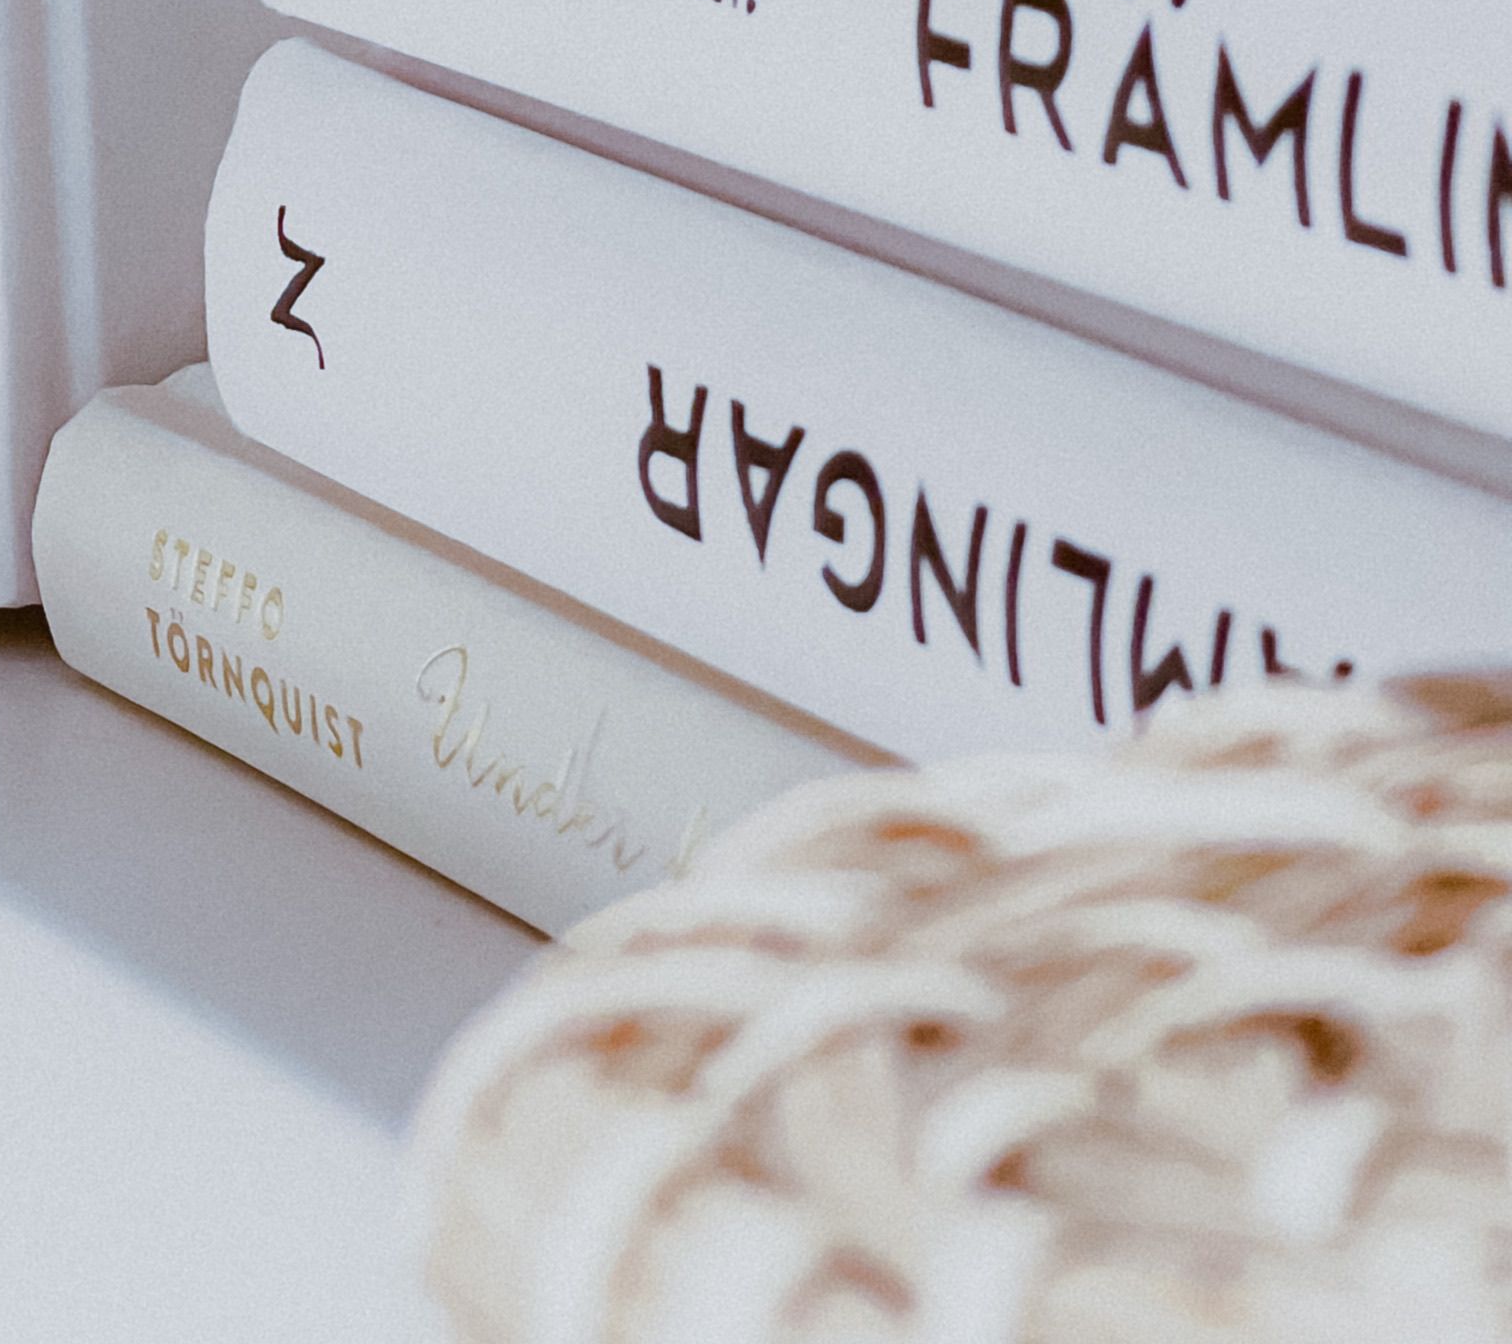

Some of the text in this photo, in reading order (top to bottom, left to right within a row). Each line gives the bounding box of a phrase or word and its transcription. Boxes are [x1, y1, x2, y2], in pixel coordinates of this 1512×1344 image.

[148, 528, 285, 641] STEFFO
[638, 362, 1354, 726] MLINGAR
[146, 606, 365, 769] TÖRNQUIST
